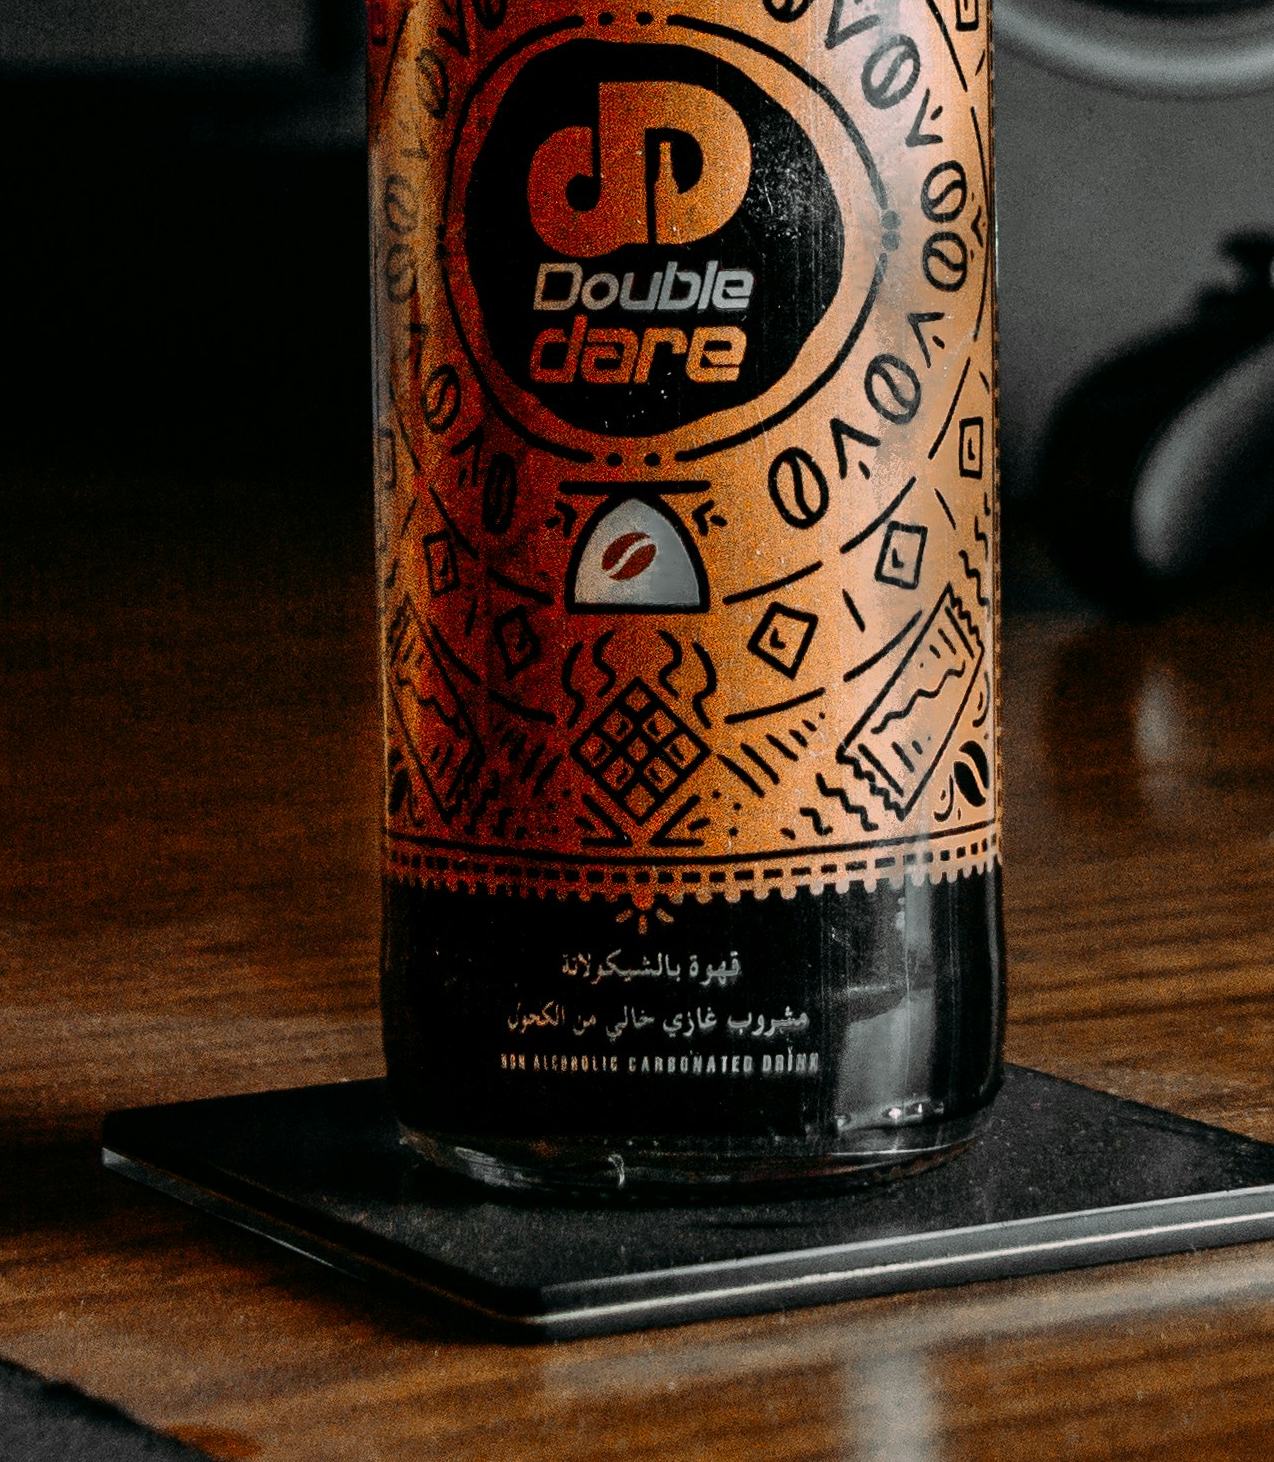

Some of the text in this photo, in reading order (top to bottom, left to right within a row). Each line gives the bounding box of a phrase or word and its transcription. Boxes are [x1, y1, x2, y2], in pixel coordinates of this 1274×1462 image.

[532, 259, 756, 312] Double
[529, 313, 748, 385] dare
[687, 949, 744, 988] قهوة
[506, 999, 811, 1044] مشروب غازي خالي من الكحول
[501, 1051, 820, 1075] NON ALCOHOLIC CARBONATED DRINK
